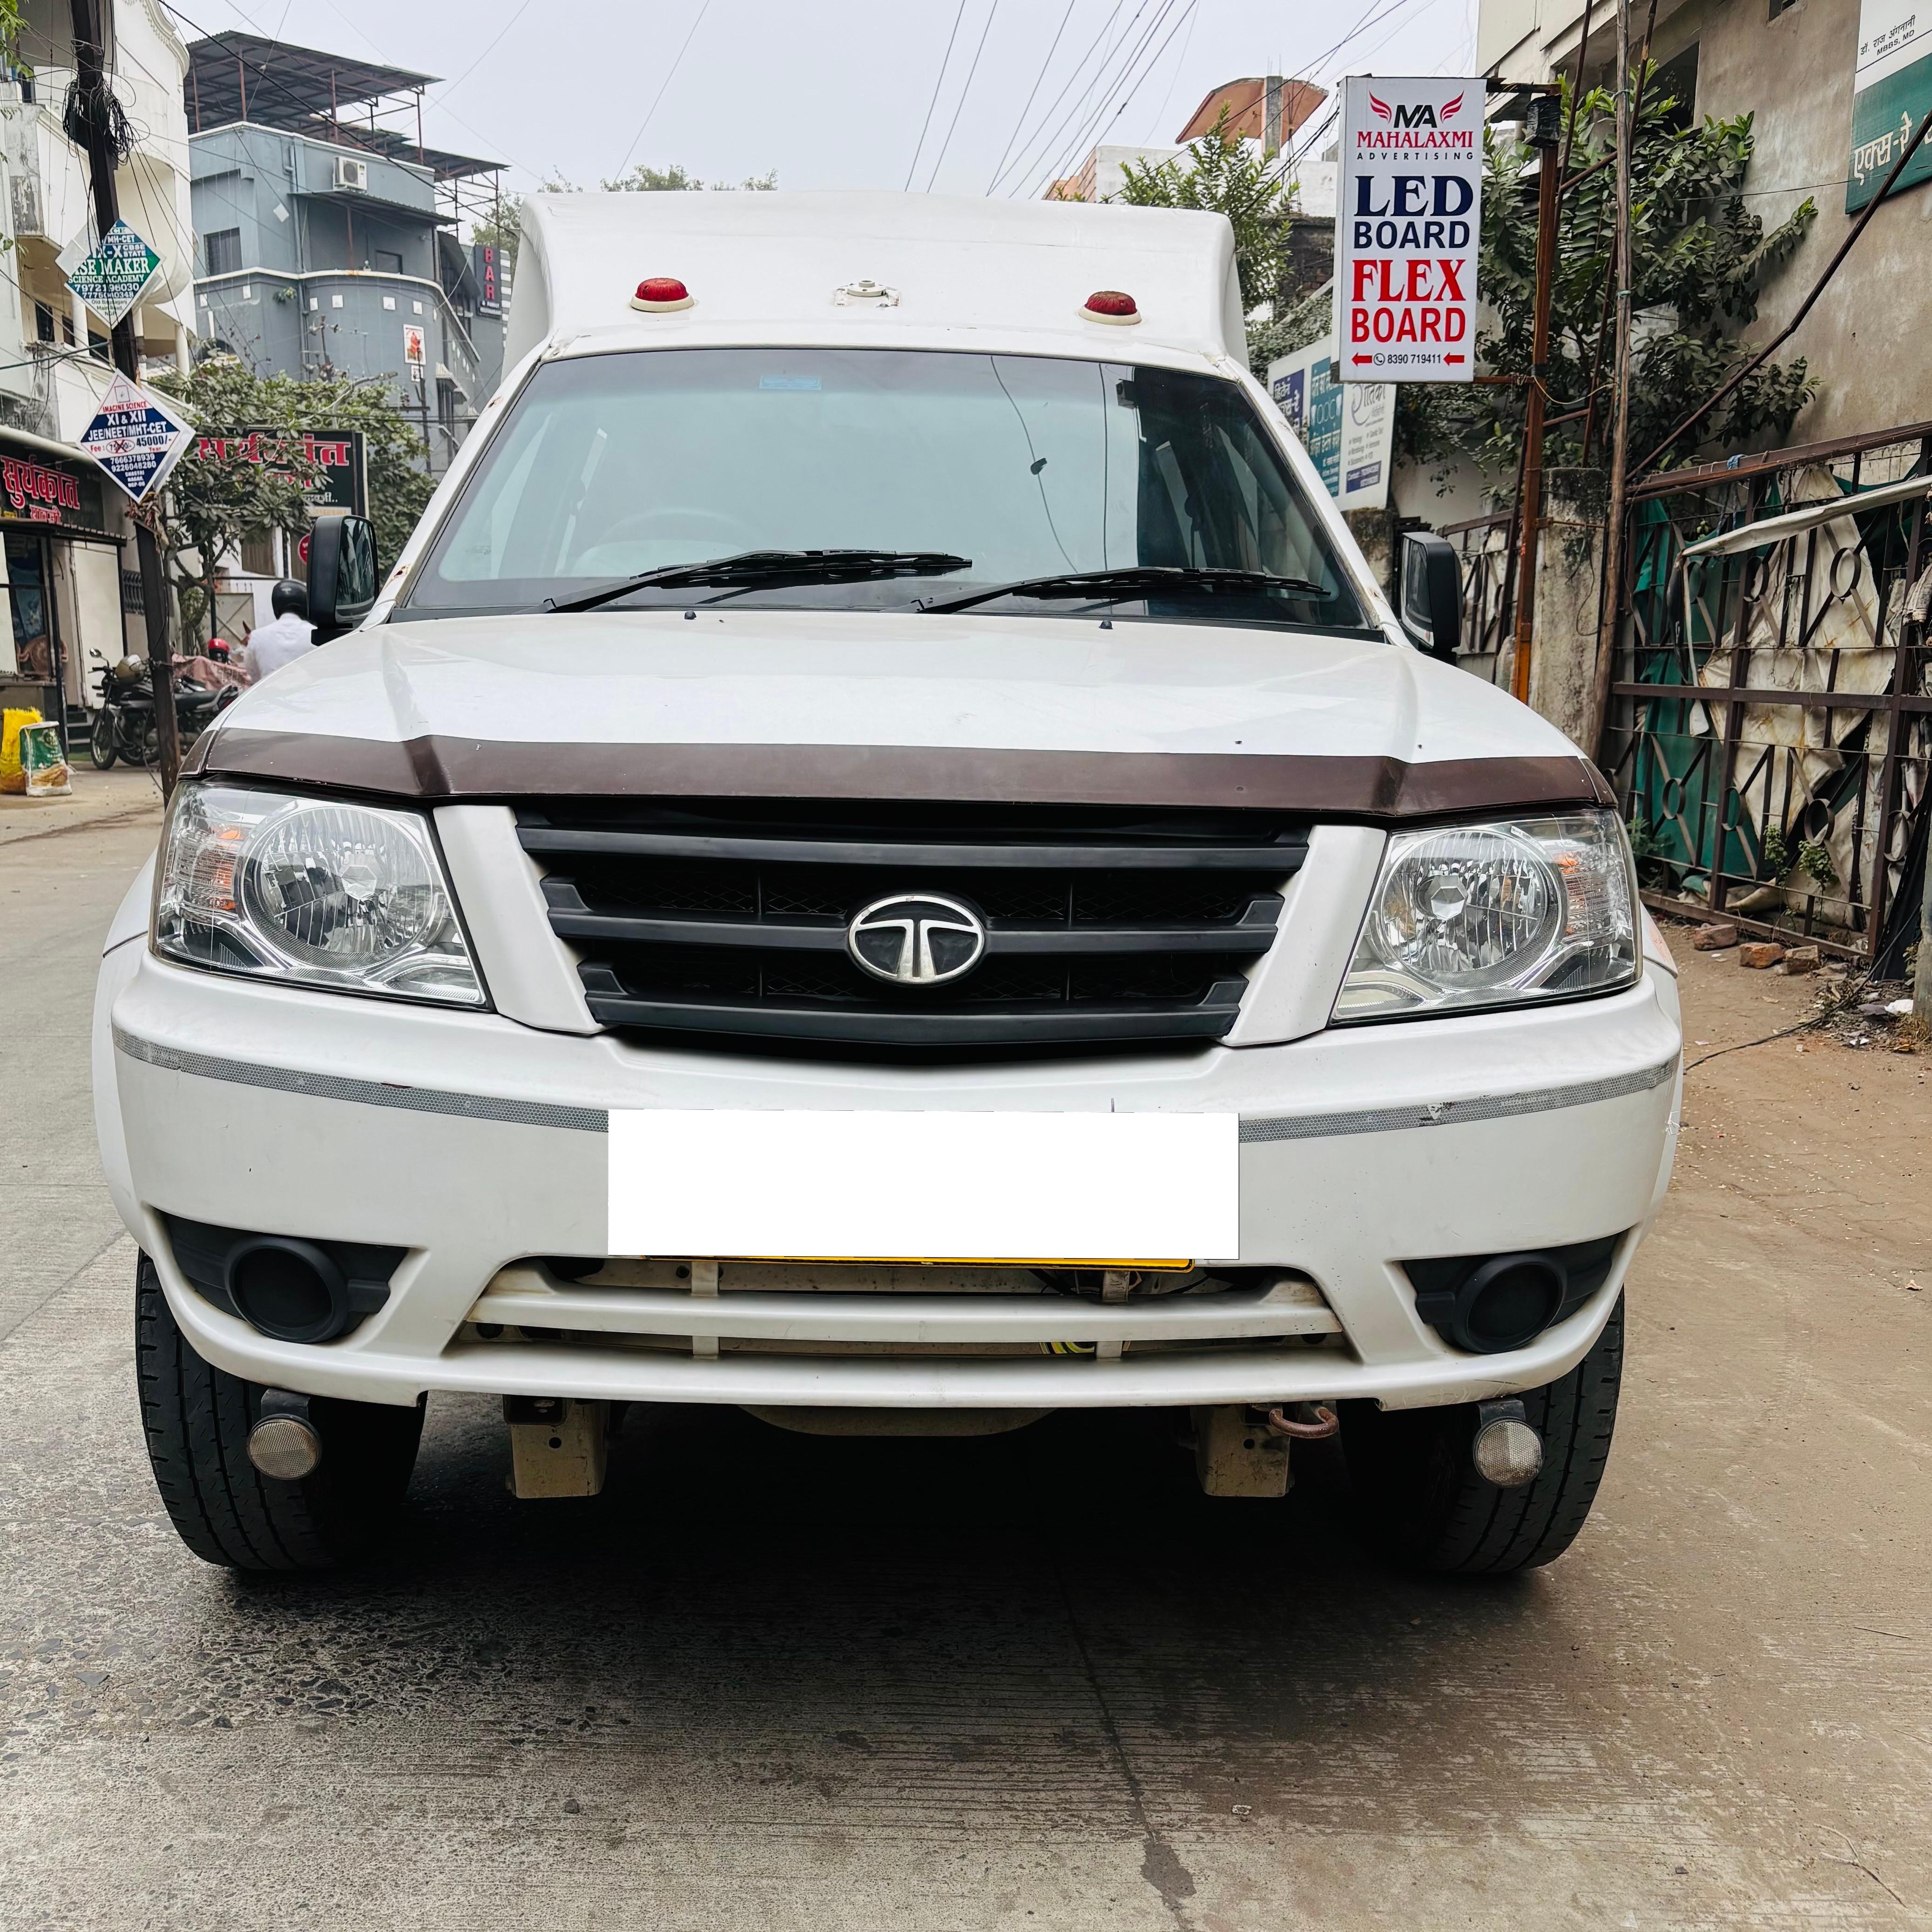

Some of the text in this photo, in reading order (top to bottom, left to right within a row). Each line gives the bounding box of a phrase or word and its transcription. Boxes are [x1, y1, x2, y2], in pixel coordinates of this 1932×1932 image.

[1873, 34, 1886, 47] राज
[1888, 14, 1916, 39] अंगनानी
[1877, 29, 1914, 55] MBBS, MD
[1393, 105, 1438, 128] MA
[1357, 131, 1473, 148] MAHALAXMI
[1353, 176, 1473, 216] LED
[102, 235, 135, 244] /MH-CET
[1353, 221, 1470, 249] BOARD
[99, 257, 150, 275] MAKER
[484, 246, 495, 300] BAR
[68, 274, 144, 284] SCIENCE ACADEMY
[1351, 259, 1466, 302] FLEX
[1351, 307, 1466, 343] BOARD
[1387, 354, 1441, 364] 8390 719411
[102, 401, 147, 413] IMAGINE SCIENCE
[106, 410, 146, 426] XI & XII
